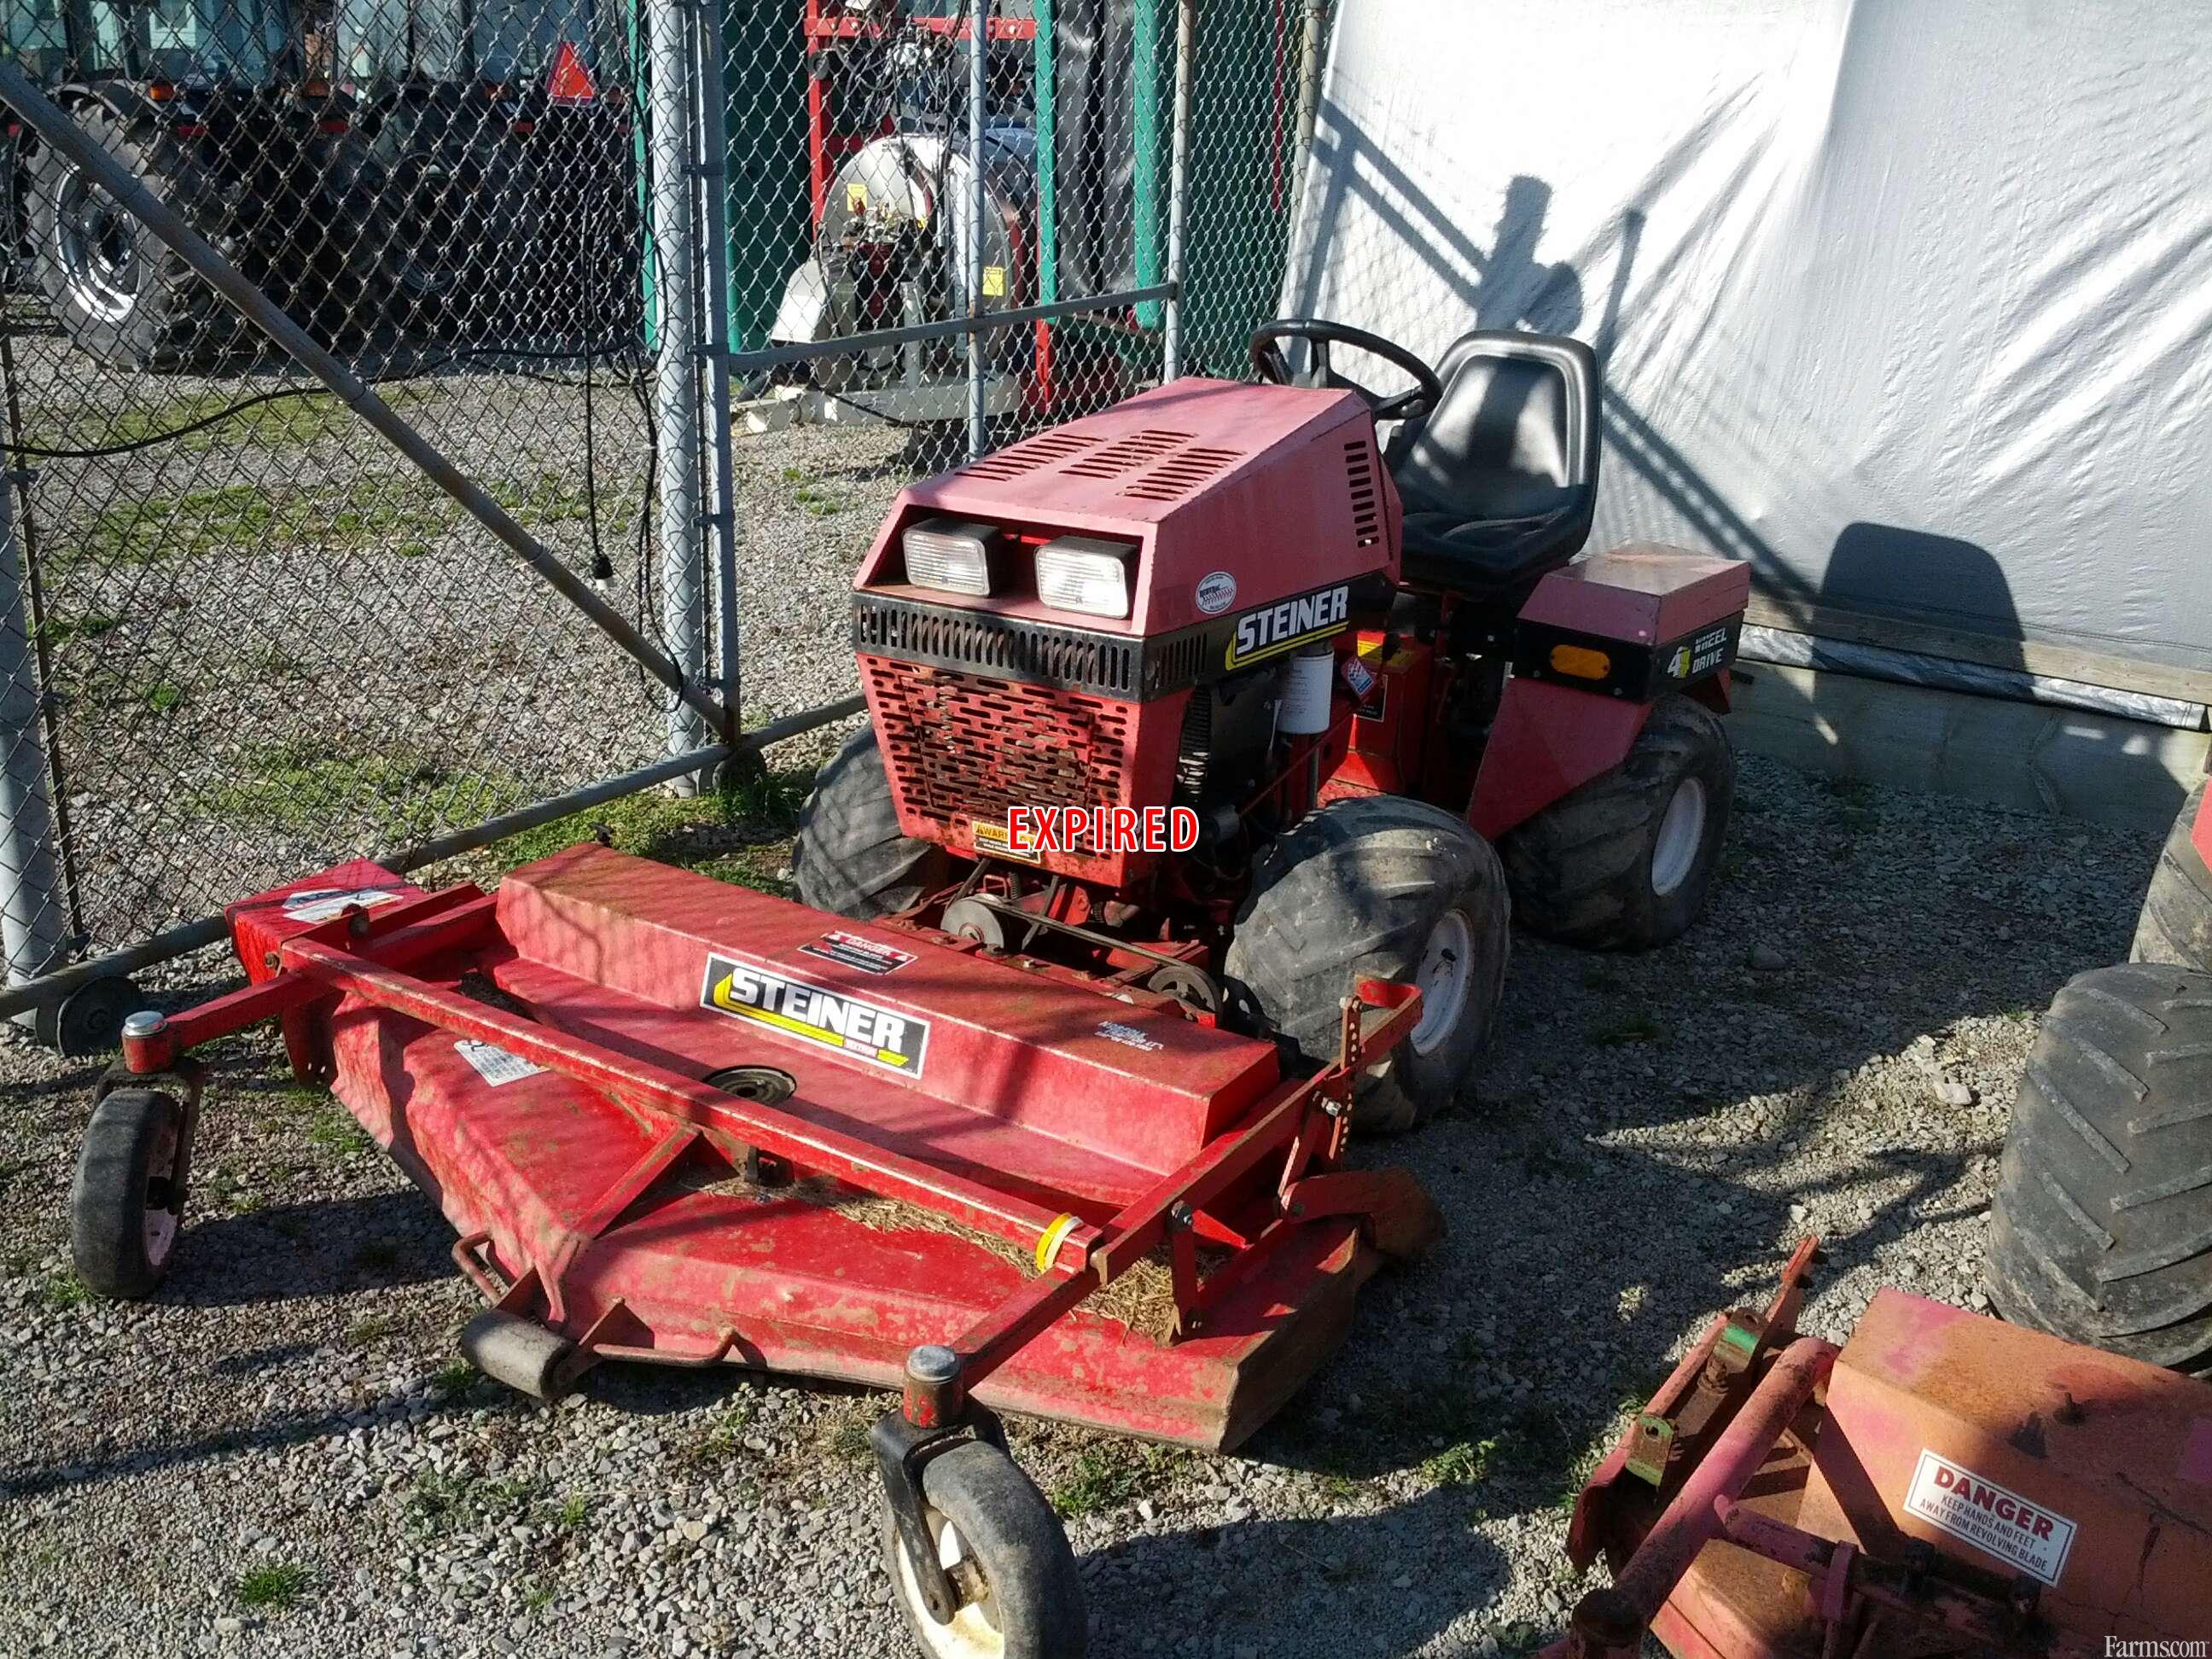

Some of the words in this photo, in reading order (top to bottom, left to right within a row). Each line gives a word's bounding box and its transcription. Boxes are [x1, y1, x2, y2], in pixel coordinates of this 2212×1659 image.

[1236, 585, 1348, 655] STEINER
[1694, 628, 1727, 654] WHEEL
[1691, 648, 1724, 674] DRIVE
[845, 938, 892, 957] DANGER
[730, 967, 905, 1054] STEINER
[1920, 1499, 1946, 1516] AWAY
[1946, 1510, 1970, 1530] FROM
[1970, 1522, 2018, 1556] REVOLVING
[2019, 1548, 2048, 1571] BLADE
[1934, 1465, 2053, 1542] DANGER
[1941, 1493, 1964, 1511] KEEP
[1964, 1505, 1994, 1528] HANDS
[1994, 1521, 2013, 1538] AND
[2014, 1532, 2035, 1549] FEET
